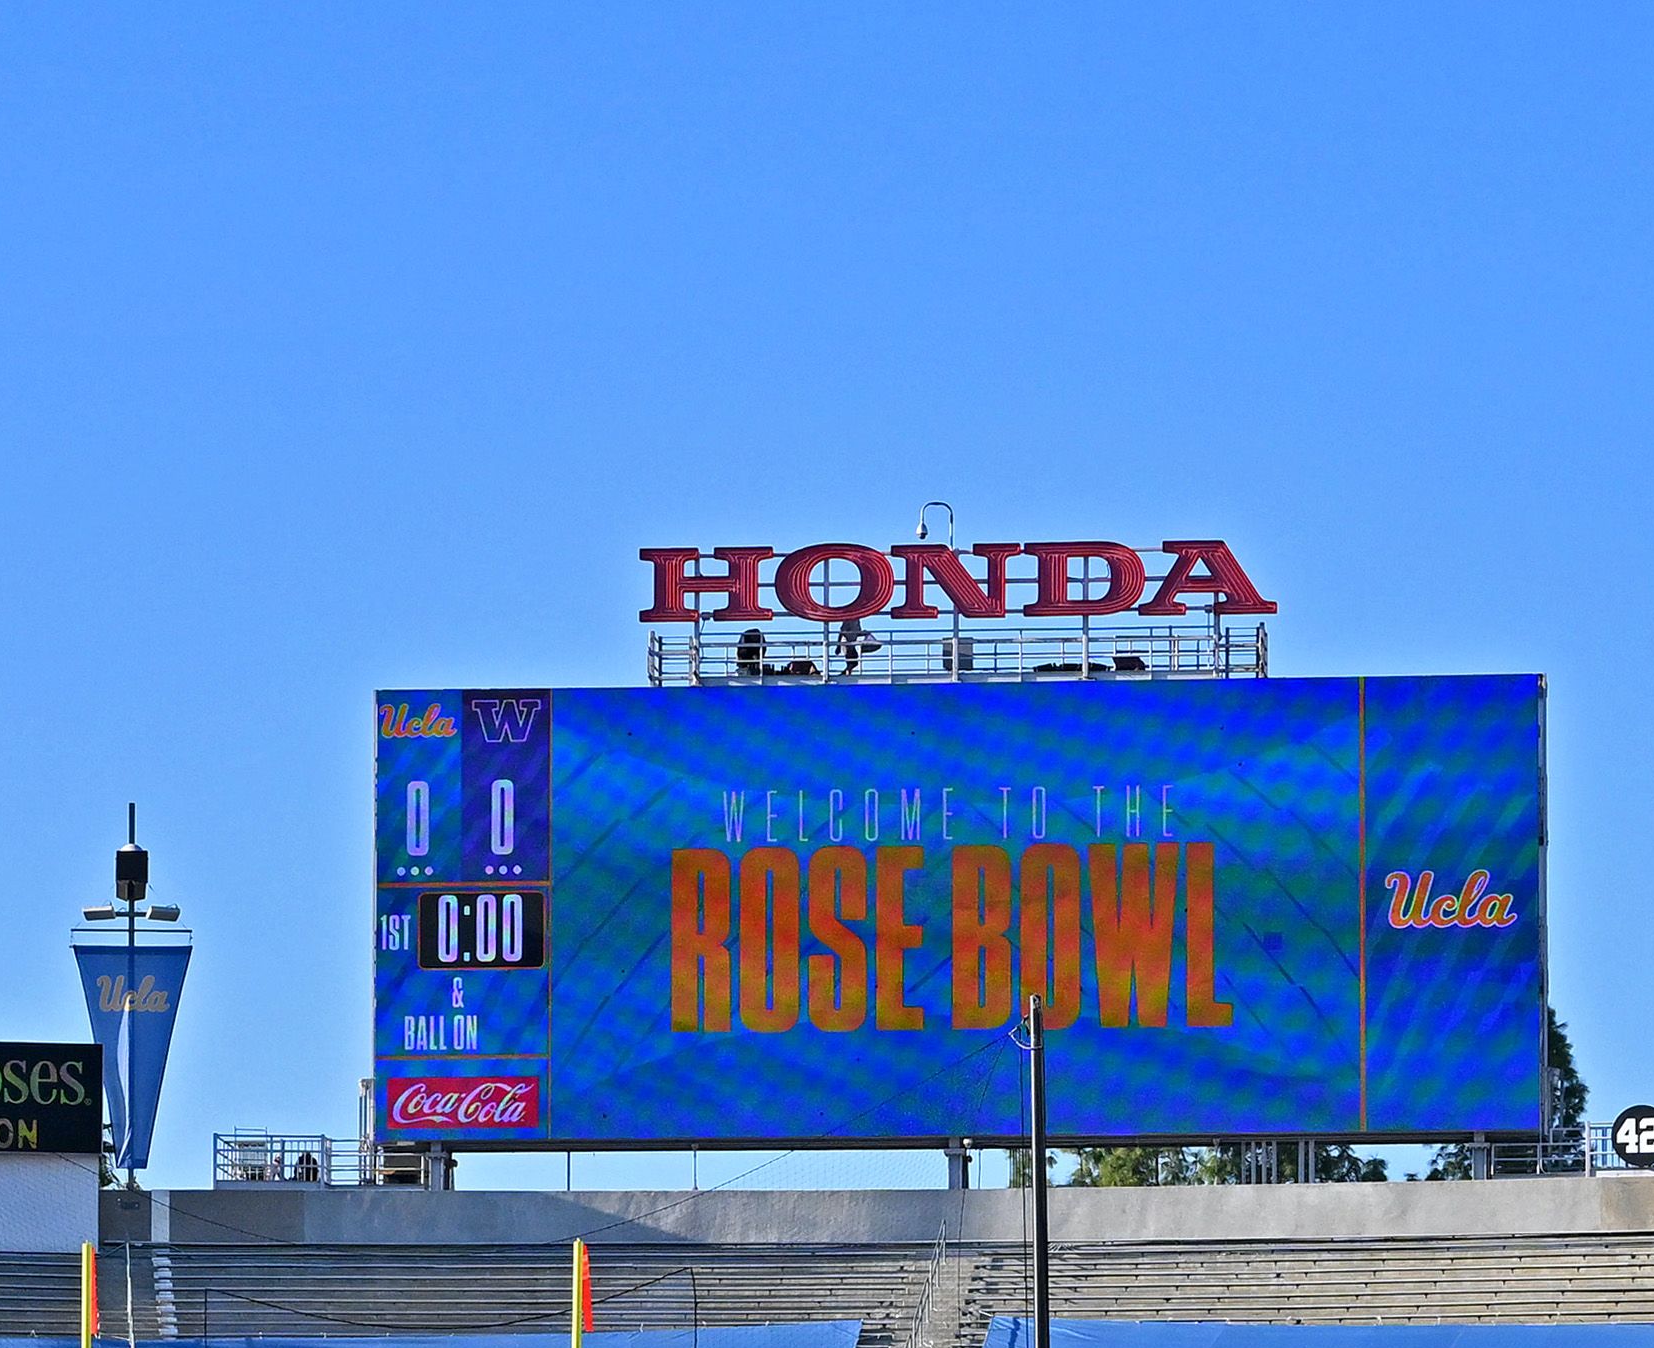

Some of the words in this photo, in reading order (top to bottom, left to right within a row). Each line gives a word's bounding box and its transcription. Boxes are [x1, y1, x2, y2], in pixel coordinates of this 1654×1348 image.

[639, 540, 1278, 623] HONDA
[472, 699, 541, 742] W
[406, 780, 430, 856] 0
[491, 779, 514, 855] 0
[722, 787, 954, 843] WELCOME
[999, 785, 1047, 840] TO
[1093, 784, 1174, 838] THE
[380, 914, 411, 951] 1ST
[438, 894, 523, 963] 0:00
[670, 845, 924, 1033] ROSE
[951, 841, 1234, 1030] BOWL
[452, 977, 464, 1008] &
[404, 1015, 446, 1051] BALL
[453, 1015, 478, 1050] ON
